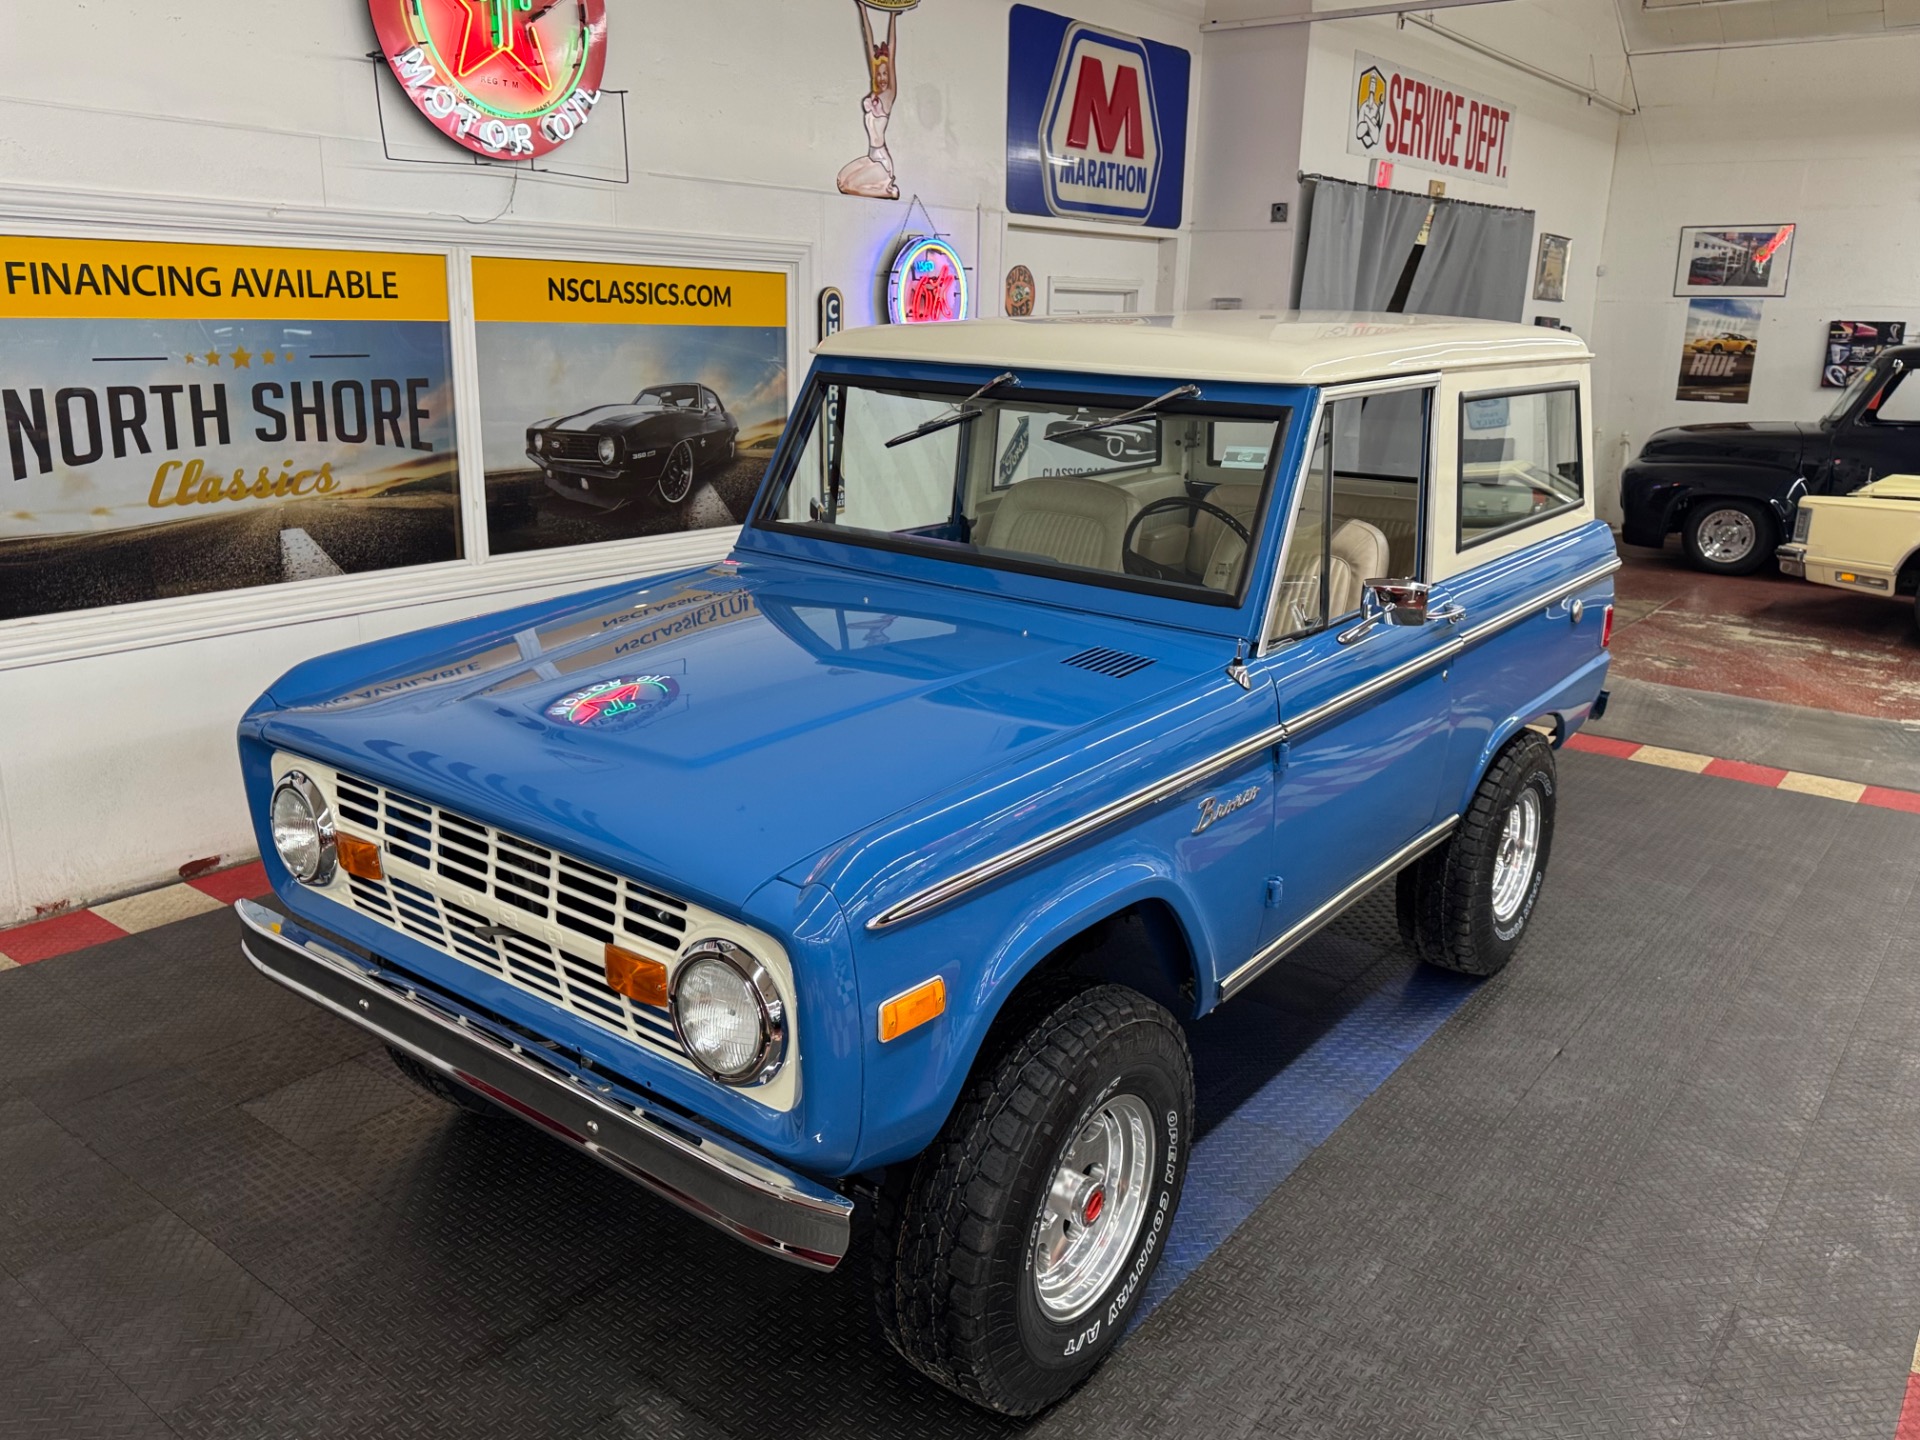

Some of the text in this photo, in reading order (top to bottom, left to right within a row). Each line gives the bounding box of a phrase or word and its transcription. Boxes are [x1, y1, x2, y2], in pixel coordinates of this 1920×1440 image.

[392, 47, 601, 154] MOTOR OIL
[1066, 55, 1145, 159] M
[1385, 73, 1510, 178] SERVICE DEPT.
[1059, 154, 1148, 194] MARATHON
[4, 261, 399, 299] FINANCING AVAILABLE
[548, 277, 732, 308] NSCLASSICS.COM
[1006, 266, 1033, 289] SUPER
[1012, 300, 1031, 317] BEE
[1688, 353, 1738, 377] RIDE
[2, 377, 434, 481] NORTH SHORE
[147, 459, 341, 509] Classics
[1191, 785, 1261, 835] Bronco
[1063, 1110, 1178, 1356] OPEN COUNTRY A/T
